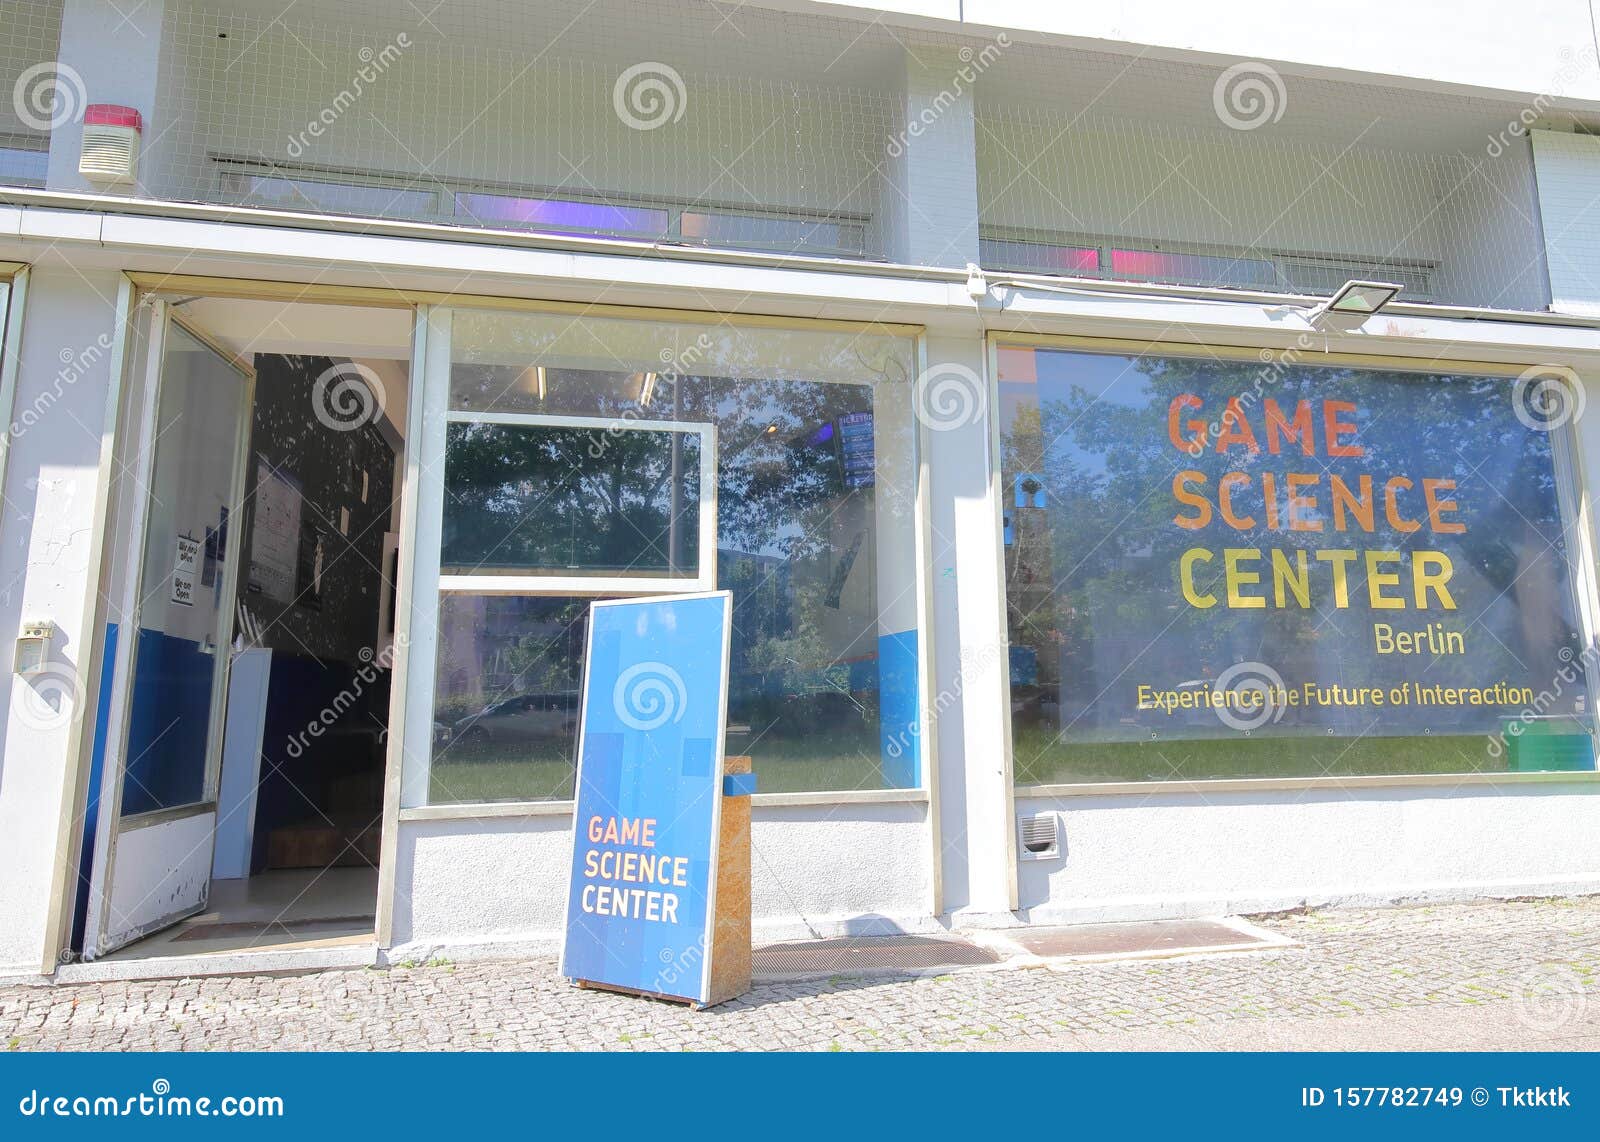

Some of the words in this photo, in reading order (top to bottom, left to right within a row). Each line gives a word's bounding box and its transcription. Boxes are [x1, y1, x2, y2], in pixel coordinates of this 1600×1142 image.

[1168, 394, 1364, 457] GAME
[1172, 470, 1467, 533] SCIENCE
[1179, 548, 1457, 610] CENTER
[1374, 623, 1465, 654] Berlin
[1137, 684, 1264, 715] Experience
[1268, 683, 1299, 708] the
[1303, 682, 1384, 706] Future
[1390, 682, 1409, 705] of
[1415, 681, 1535, 705] Interaction
[588, 815, 657, 847] GAME
[584, 849, 689, 887] SCIENCE
[581, 884, 678, 924] CENTER
